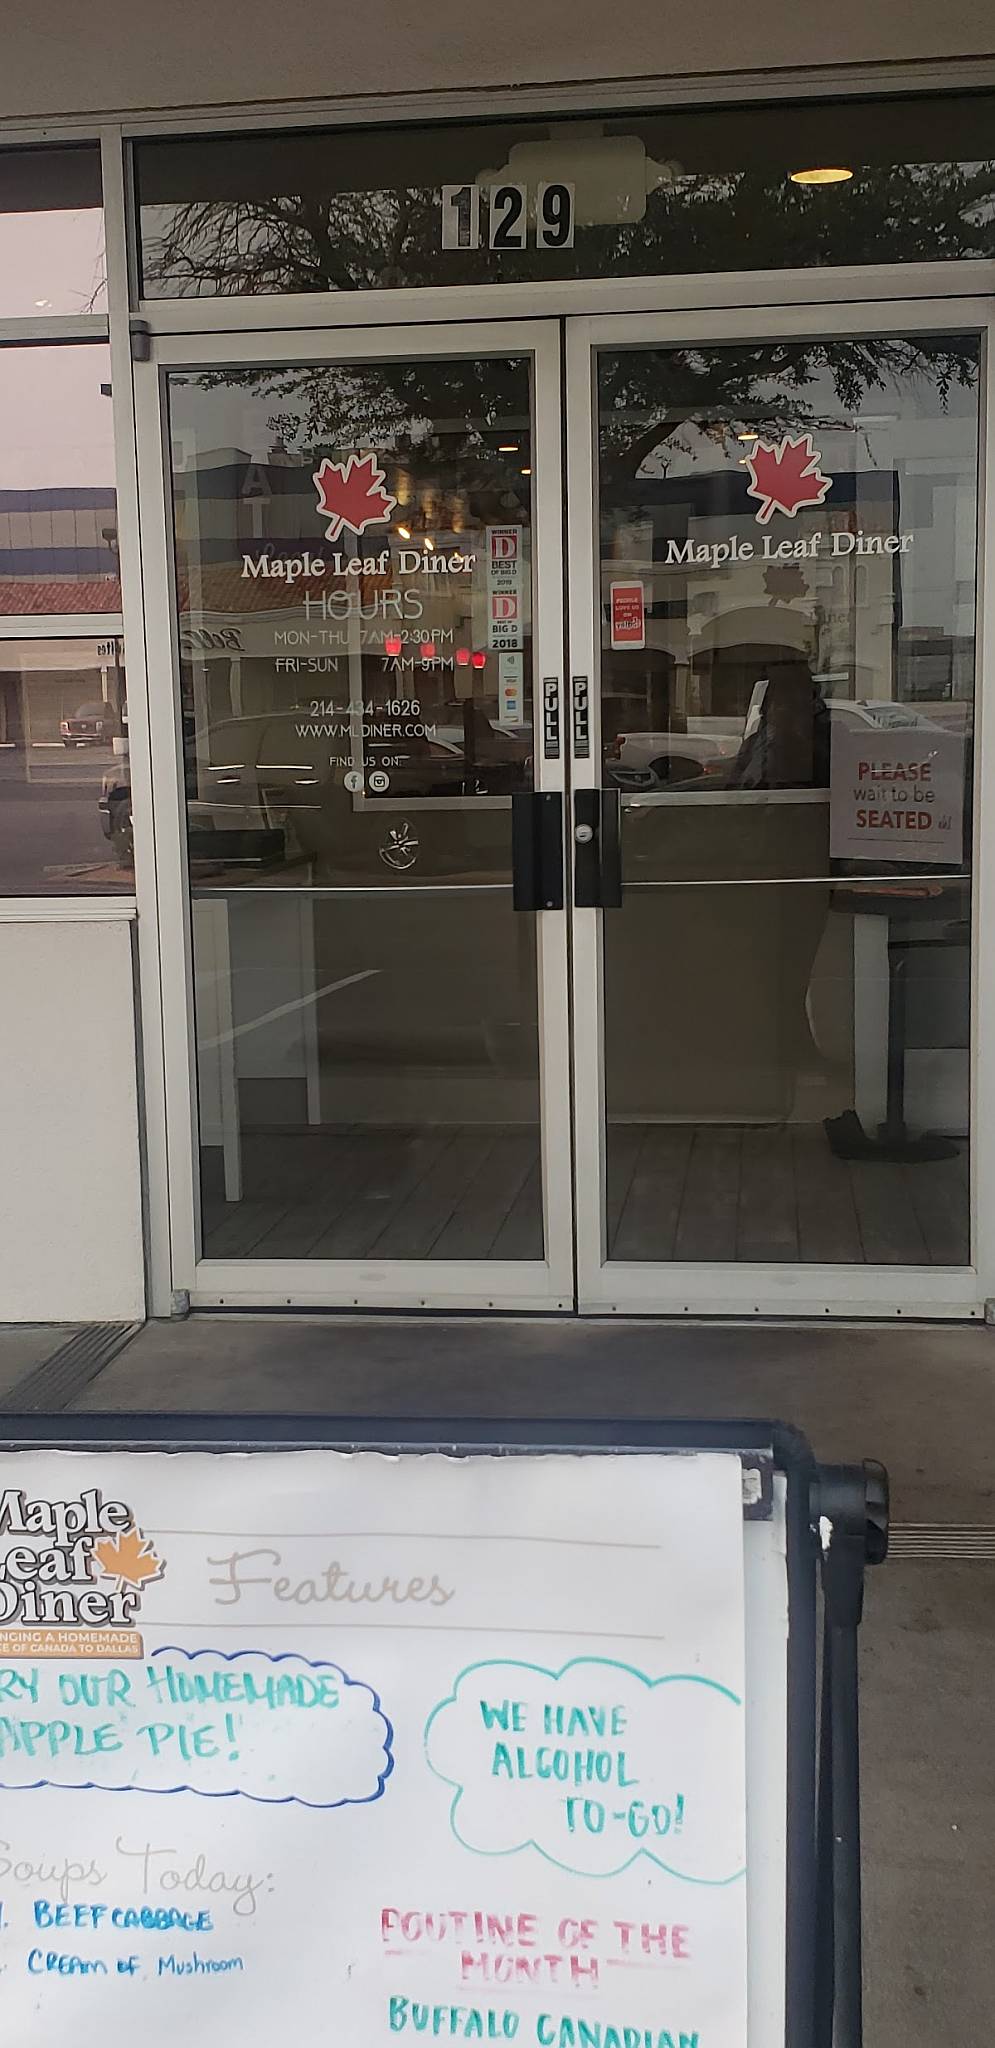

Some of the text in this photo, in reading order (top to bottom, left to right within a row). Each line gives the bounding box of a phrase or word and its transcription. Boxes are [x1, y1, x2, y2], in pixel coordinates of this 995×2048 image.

[450, 184, 571, 248] 129
[491, 560, 517, 569] BEST
[665, 529, 914, 569] Maple Leaf Diner
[240, 549, 477, 584] Maple Leaf Diner
[303, 590, 423, 621] HOURS
[274, 630, 349, 646] MON-THU
[492, 624, 518, 633] BIG D
[492, 639, 518, 648] 2018
[274, 656, 454, 673] FRI-SUN 7AM-9PM
[309, 699, 421, 717] 214-434-1626
[545, 683, 557, 740] PULL
[574, 682, 587, 739] PULL
[295, 723, 437, 738] WWW.MLDINER.COM
[329, 756, 355, 767] FIND
[362, 756, 376, 766] US
[858, 761, 931, 782] PLEASE
[853, 784, 935, 803] wait to be
[856, 809, 932, 830] SEATED
[0, 1536, 94, 1582] eaf
[207, 1547, 456, 1606] Features
[12, 1644, 28, 1652] OF
[31, 1644, 77, 1653] CANADA
[79, 1645, 94, 1653] TO
[97, 1645, 138, 1654] DALLAS
[45, 1632, 55, 1642] A
[58, 1633, 137, 1644] HOMEMADE
[58, 1668, 136, 1707] OUR
[146, 1664, 341, 1710] HOMEMADE
[480, 1700, 628, 1737] WE HAVE
[0, 1712, 241, 1762] APPLE PIE!
[491, 1742, 640, 1787] ALCOHOL
[116, 1835, 275, 1916] Today:
[33, 1898, 108, 1929] BEEF
[111, 1906, 214, 1932] CABBAGE
[380, 1907, 691, 1959] POUTINE OF THE
[157, 1951, 244, 1976] Mushroom
[460, 1949, 599, 1989] MONTH
[388, 1994, 520, 2039] BUFFALO
